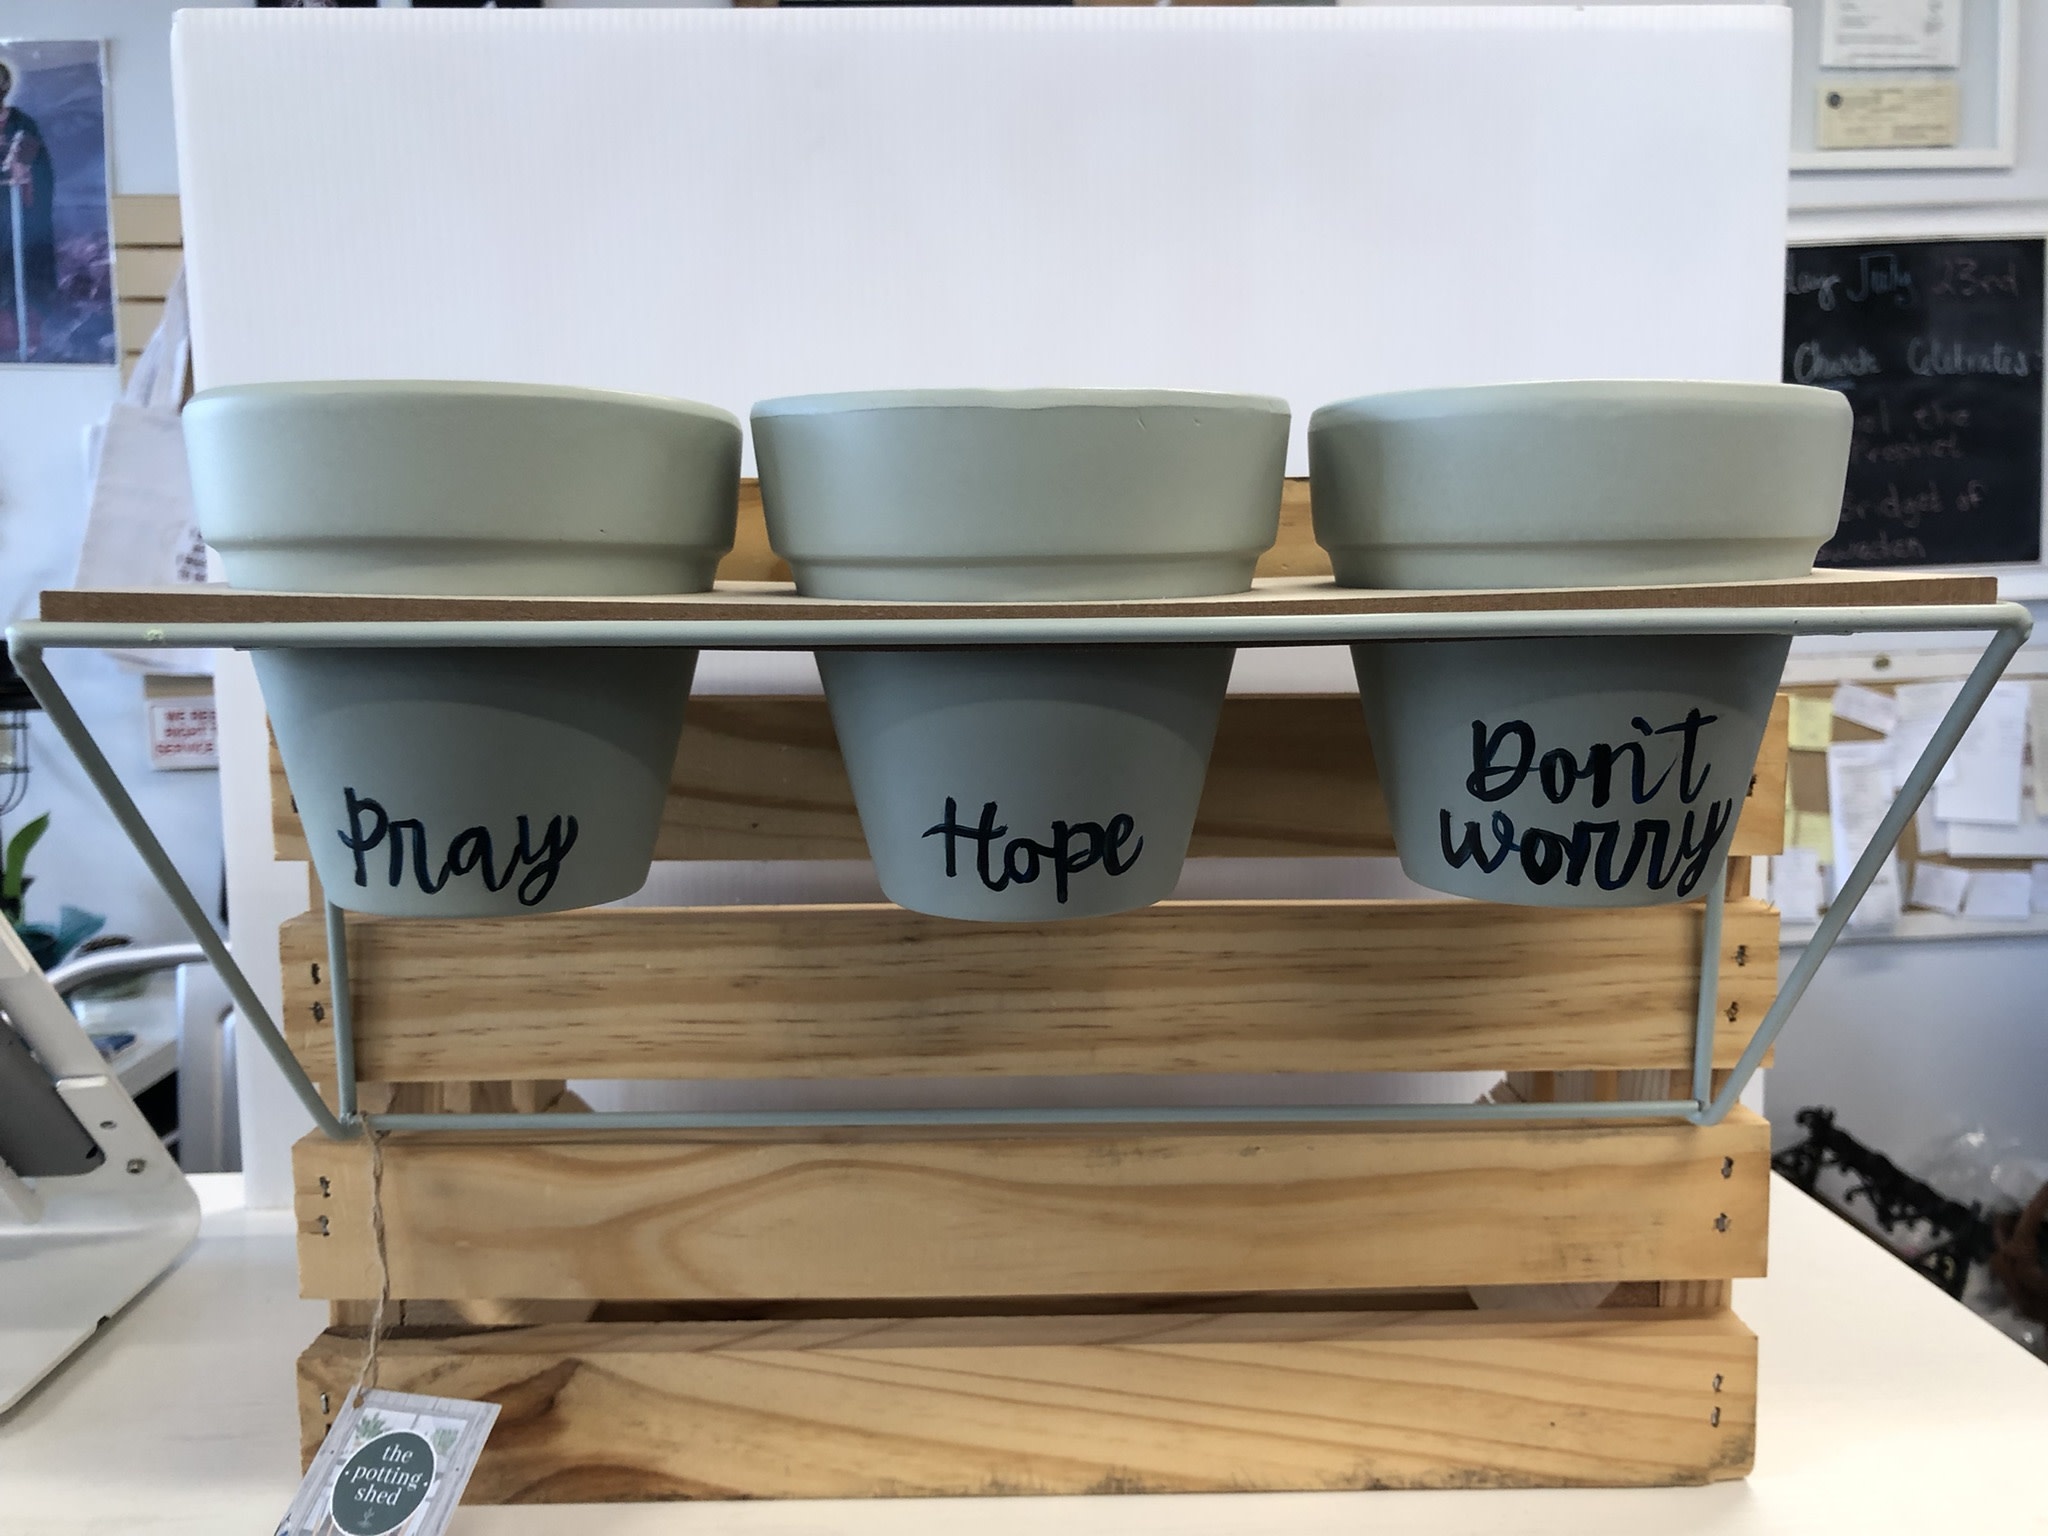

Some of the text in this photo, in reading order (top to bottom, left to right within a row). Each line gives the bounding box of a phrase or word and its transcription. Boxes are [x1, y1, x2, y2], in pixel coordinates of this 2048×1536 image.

[1466, 708, 1717, 808] Don't
[337, 787, 578, 906] Pray
[922, 795, 1143, 904] Hope
[350, 1466, 423, 1492] potting
[382, 1444, 413, 1464] the
[354, 1483, 402, 1506] shed
